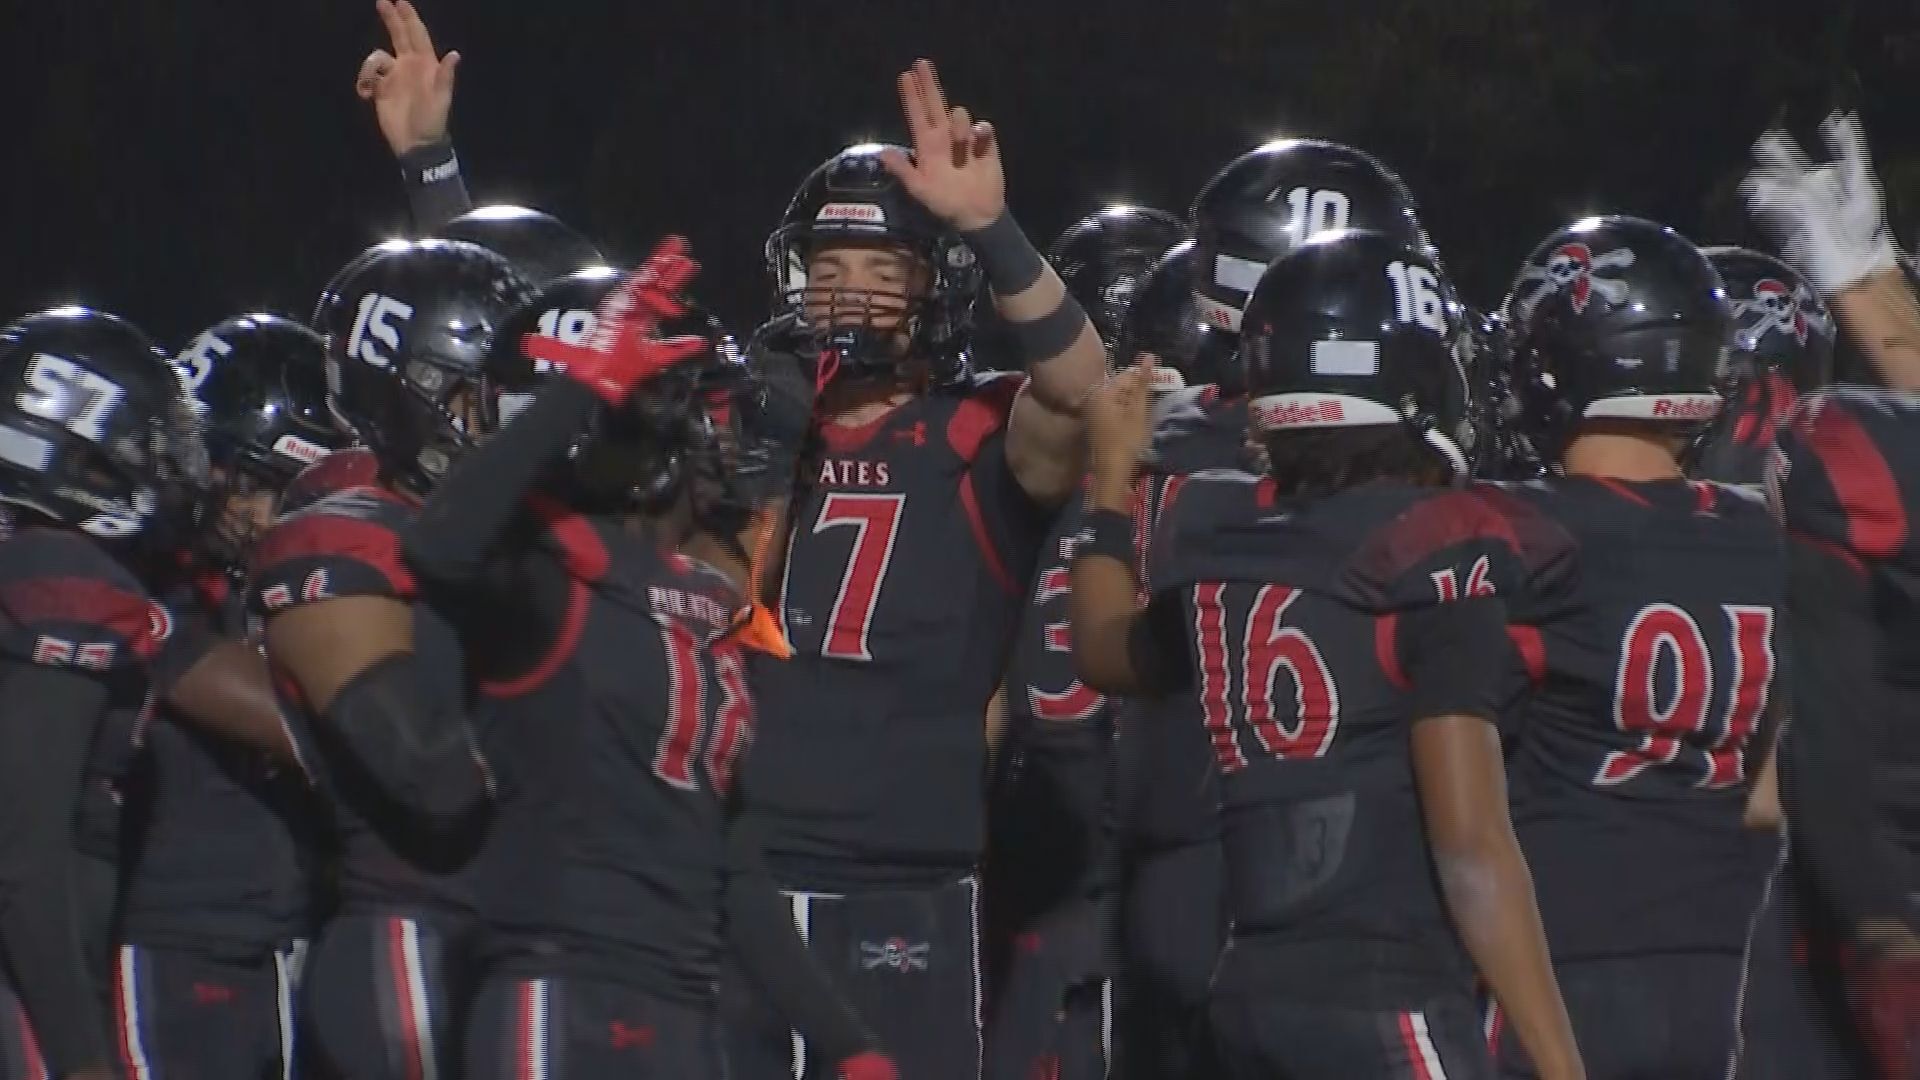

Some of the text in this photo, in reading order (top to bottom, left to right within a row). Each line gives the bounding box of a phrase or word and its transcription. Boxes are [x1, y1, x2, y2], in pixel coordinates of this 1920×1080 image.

[823, 205, 877, 219] Riddell
[1280, 187, 1350, 247] 10
[347, 292, 414, 368] 15
[1384, 260, 1448, 338] 16
[15, 352, 126, 442] 57
[1252, 400, 1346, 431] Riddell
[819, 458, 890, 486] ATES
[781, 492, 906, 663] 7
[1429, 554, 1496, 602] 16
[1194, 582, 1340, 773] 16
[1592, 603, 1776, 788] 91
